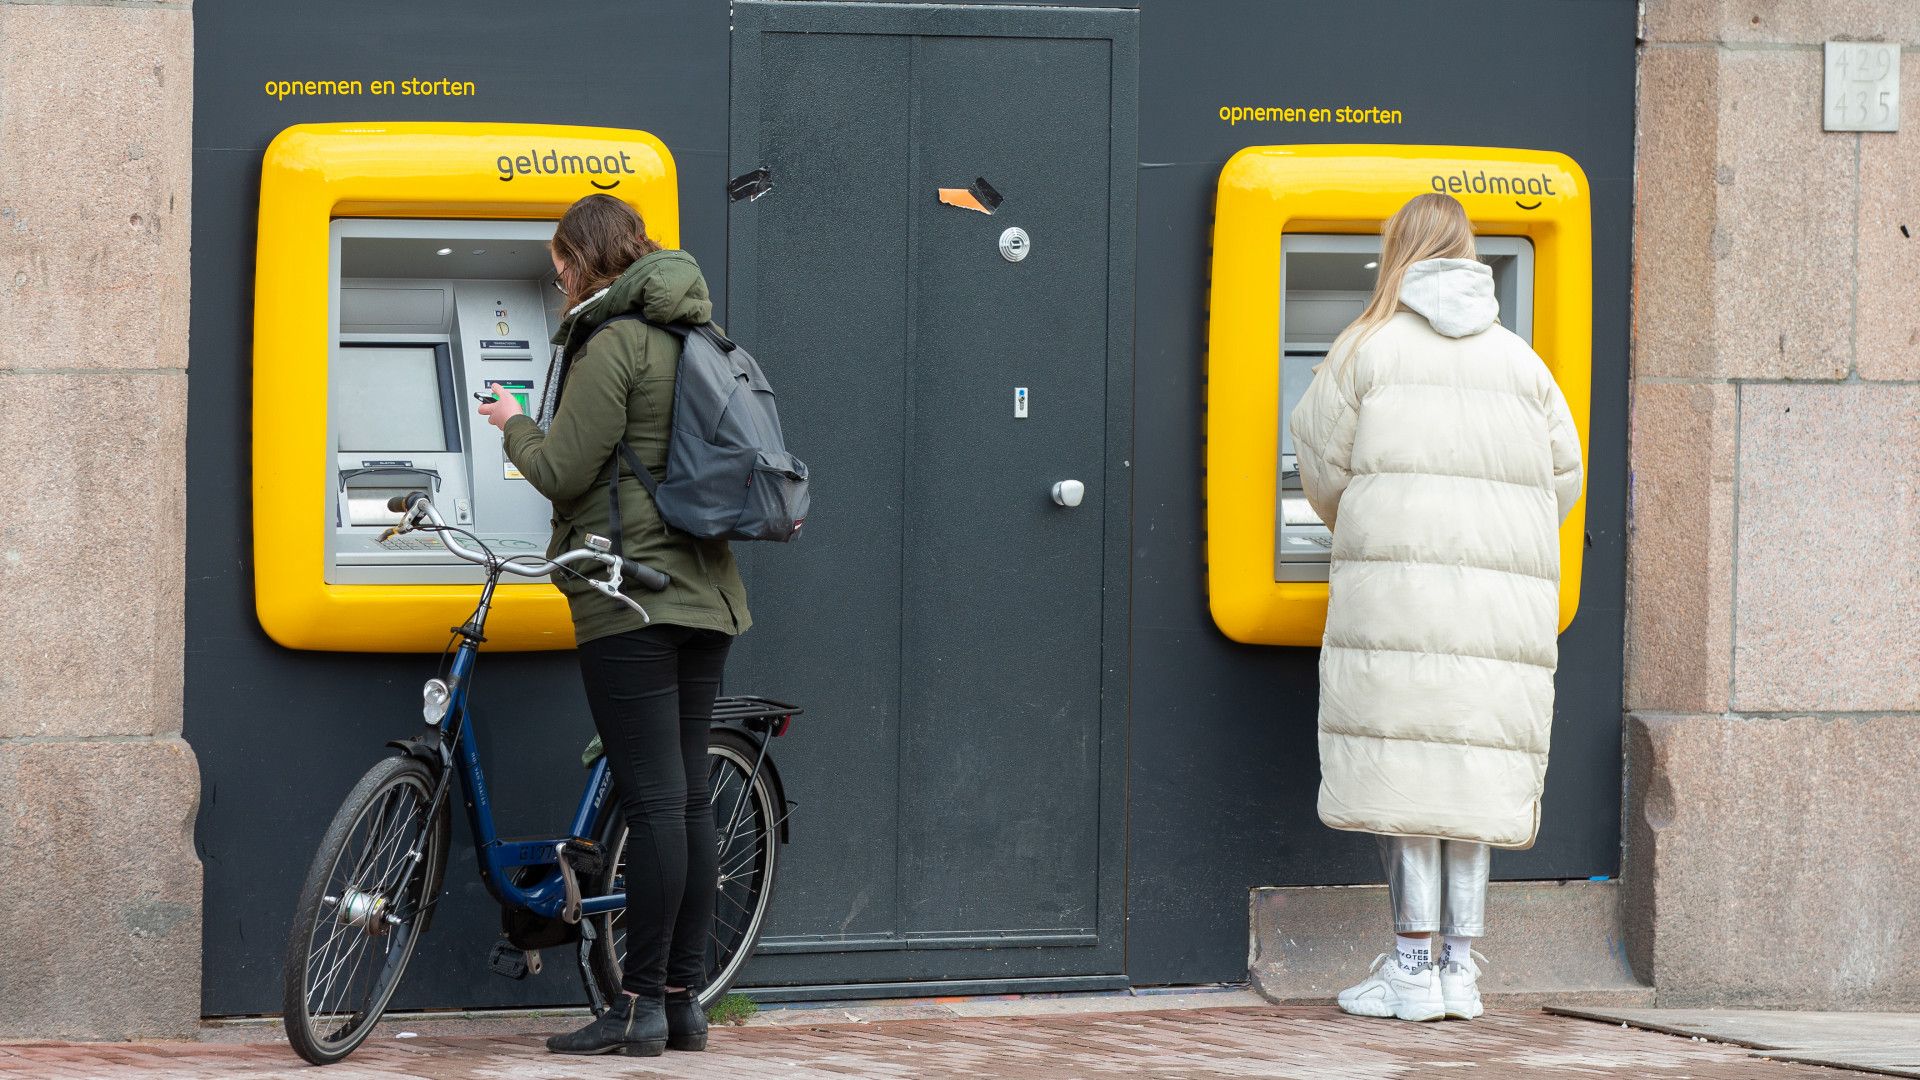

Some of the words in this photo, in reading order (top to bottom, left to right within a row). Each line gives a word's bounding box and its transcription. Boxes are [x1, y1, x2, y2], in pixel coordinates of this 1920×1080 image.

[1833, 47, 1892, 83] 429
[264, 77, 363, 102] opnemen
[370, 79, 395, 96] en
[401, 76, 476, 97] storten
[1219, 105, 1306, 126] opnemen
[1309, 107, 1332, 123] en
[1336, 106, 1403, 124] storten
[1832, 90, 1891, 125] 435
[496, 149, 636, 182] geldmaat
[1431, 171, 1557, 196] geldmaat
